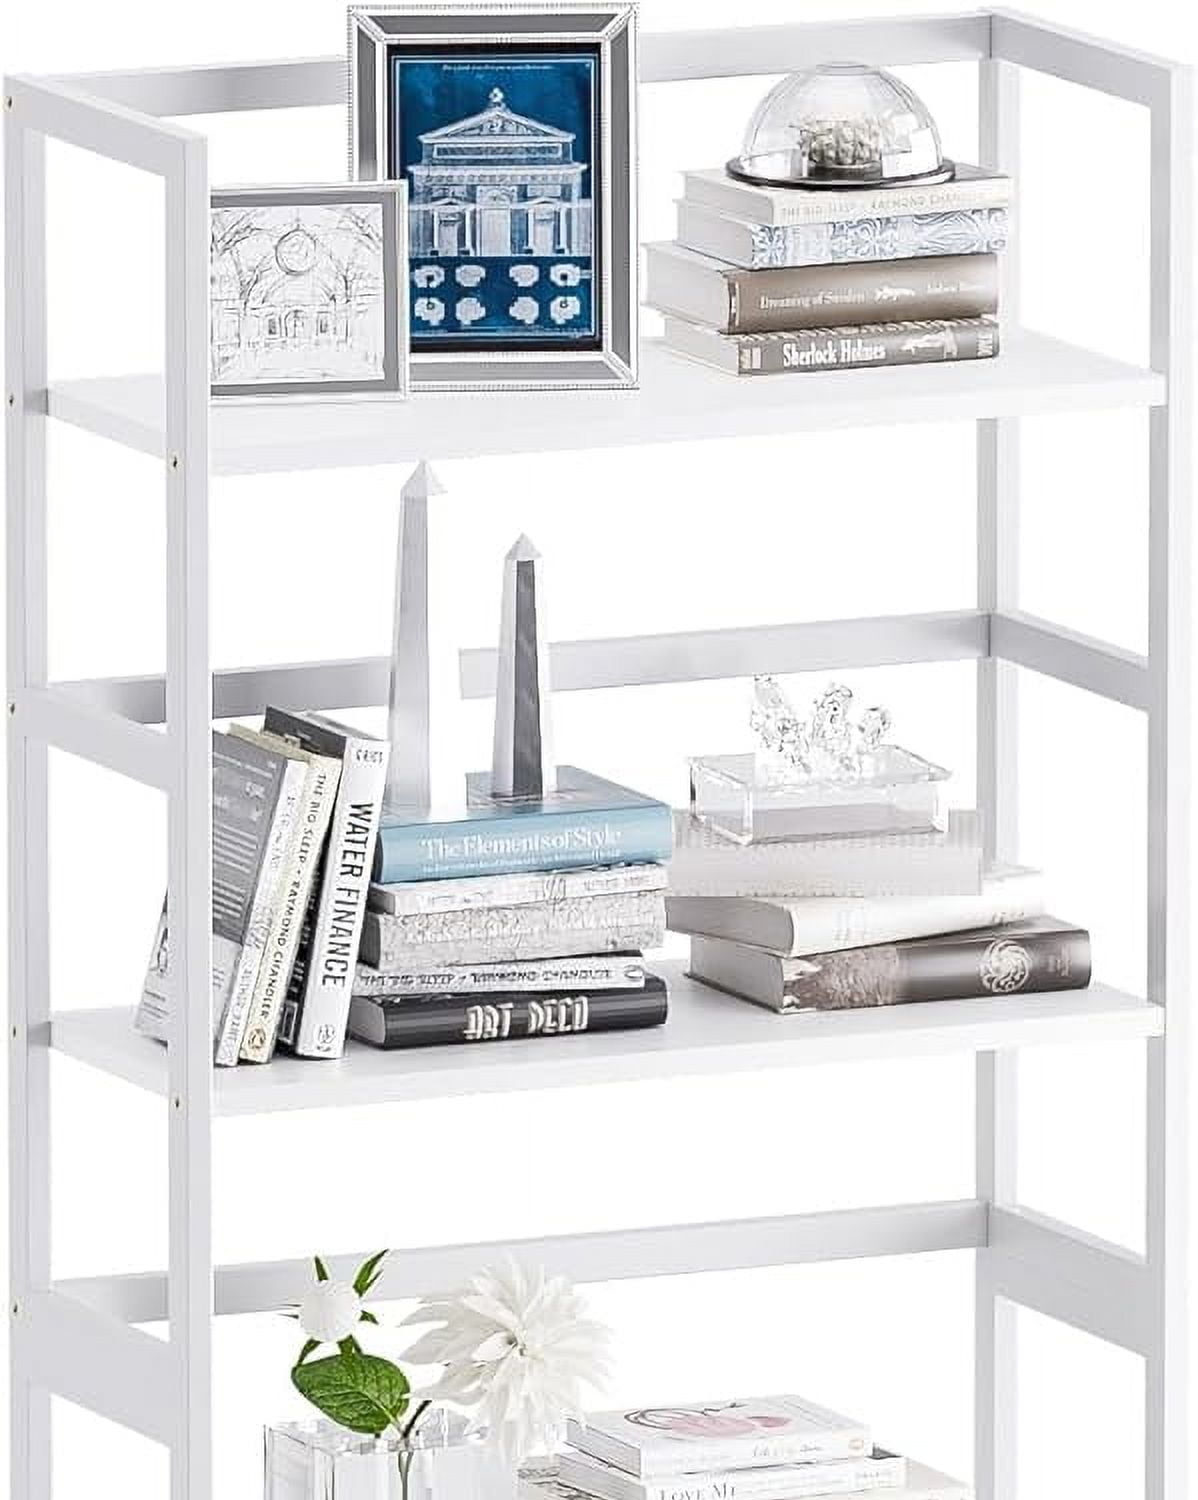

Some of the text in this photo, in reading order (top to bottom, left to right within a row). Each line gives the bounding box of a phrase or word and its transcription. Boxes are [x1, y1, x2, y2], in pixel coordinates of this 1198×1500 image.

[783, 338, 887, 367] Sherlock Holmes
[339, 802, 375, 878] WATER
[463, 831, 550, 855] Elements
[321, 882, 363, 989] FINANCE
[463, 996, 589, 1041] ART DECO
